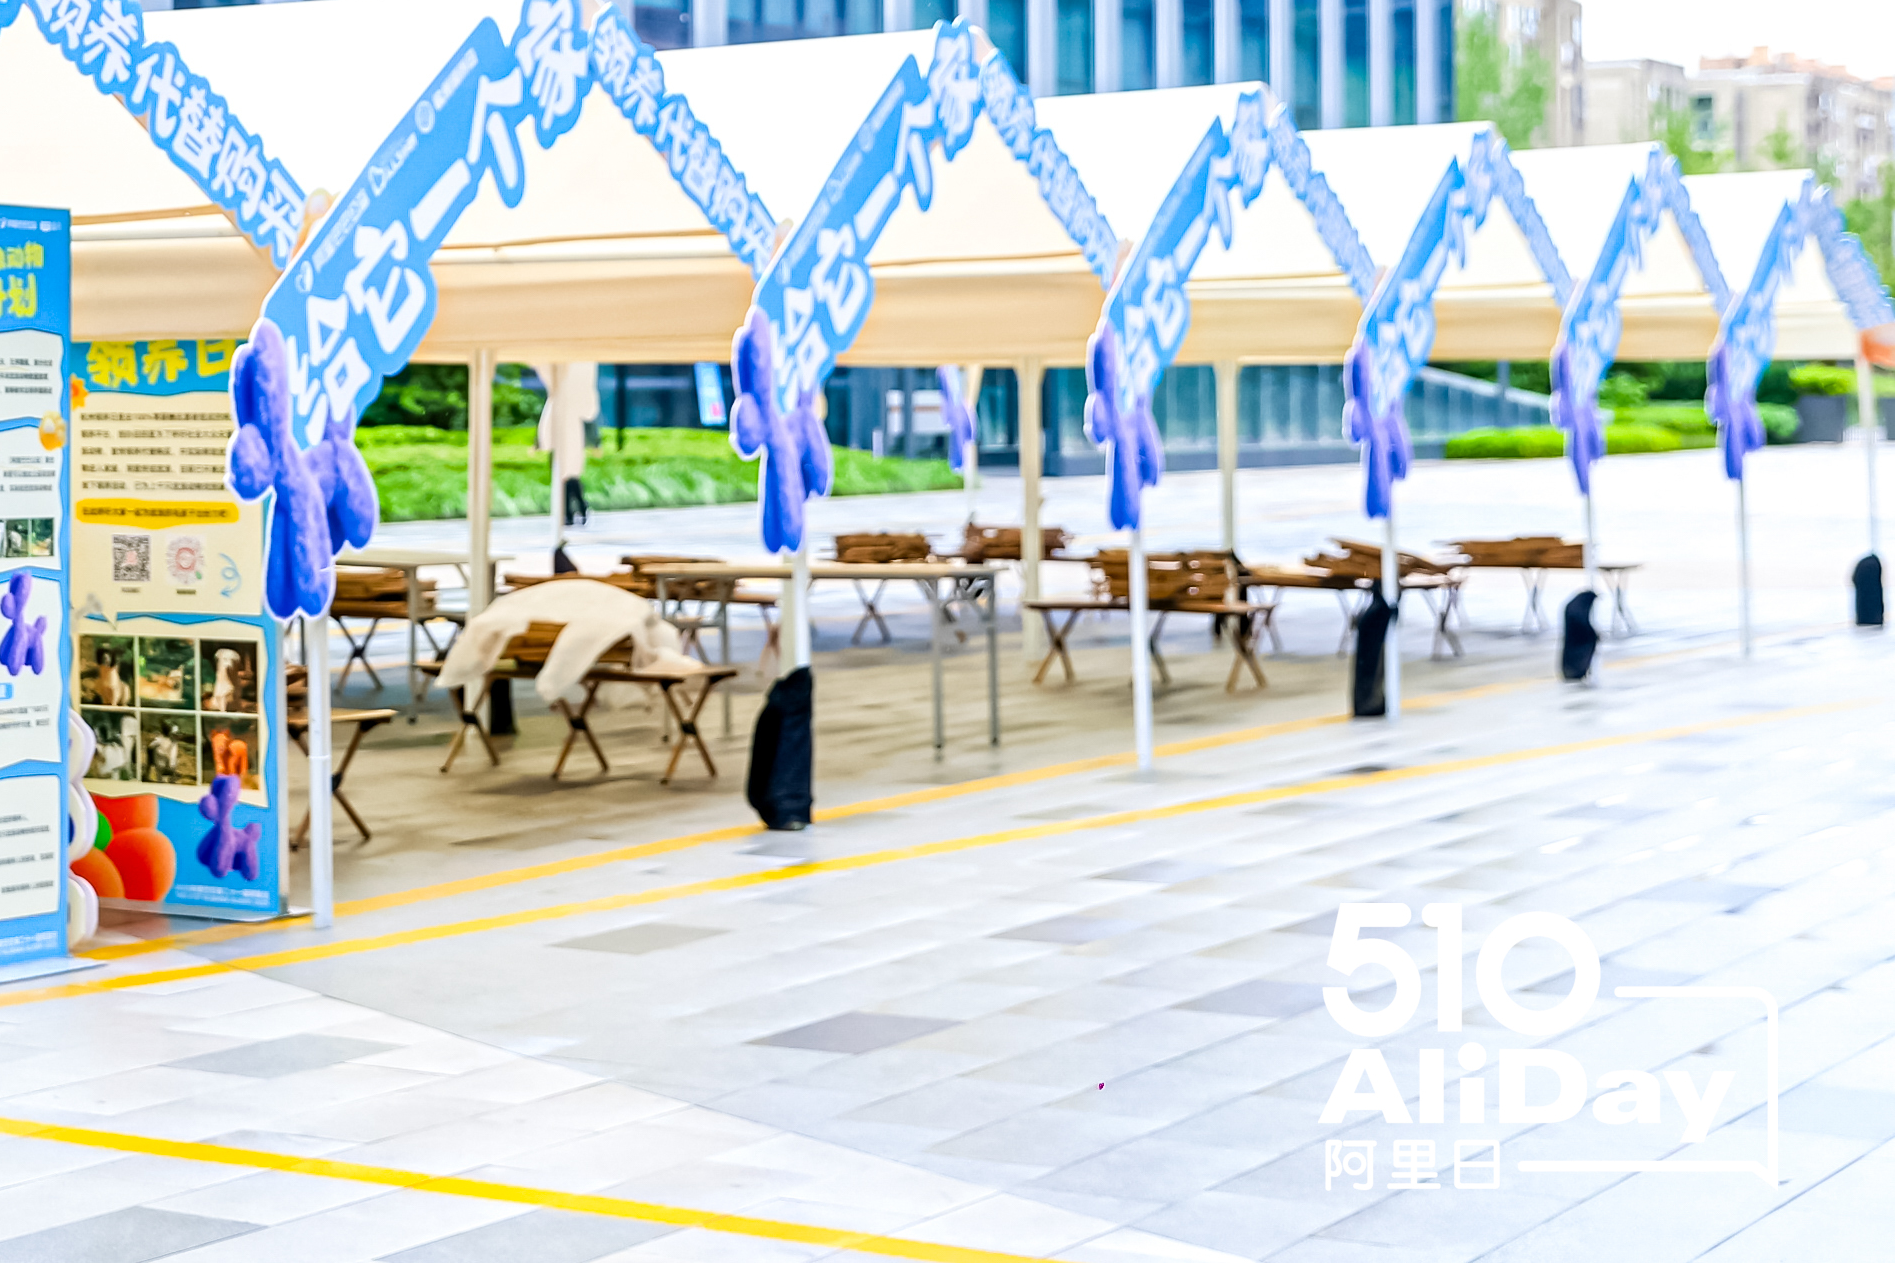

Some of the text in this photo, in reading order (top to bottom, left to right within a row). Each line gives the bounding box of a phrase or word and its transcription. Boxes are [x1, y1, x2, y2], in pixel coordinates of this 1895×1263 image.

[594, 16, 779, 276] 领养代替购买
[770, 35, 981, 412] 给它一个家
[87, 339, 236, 388] 领养日
